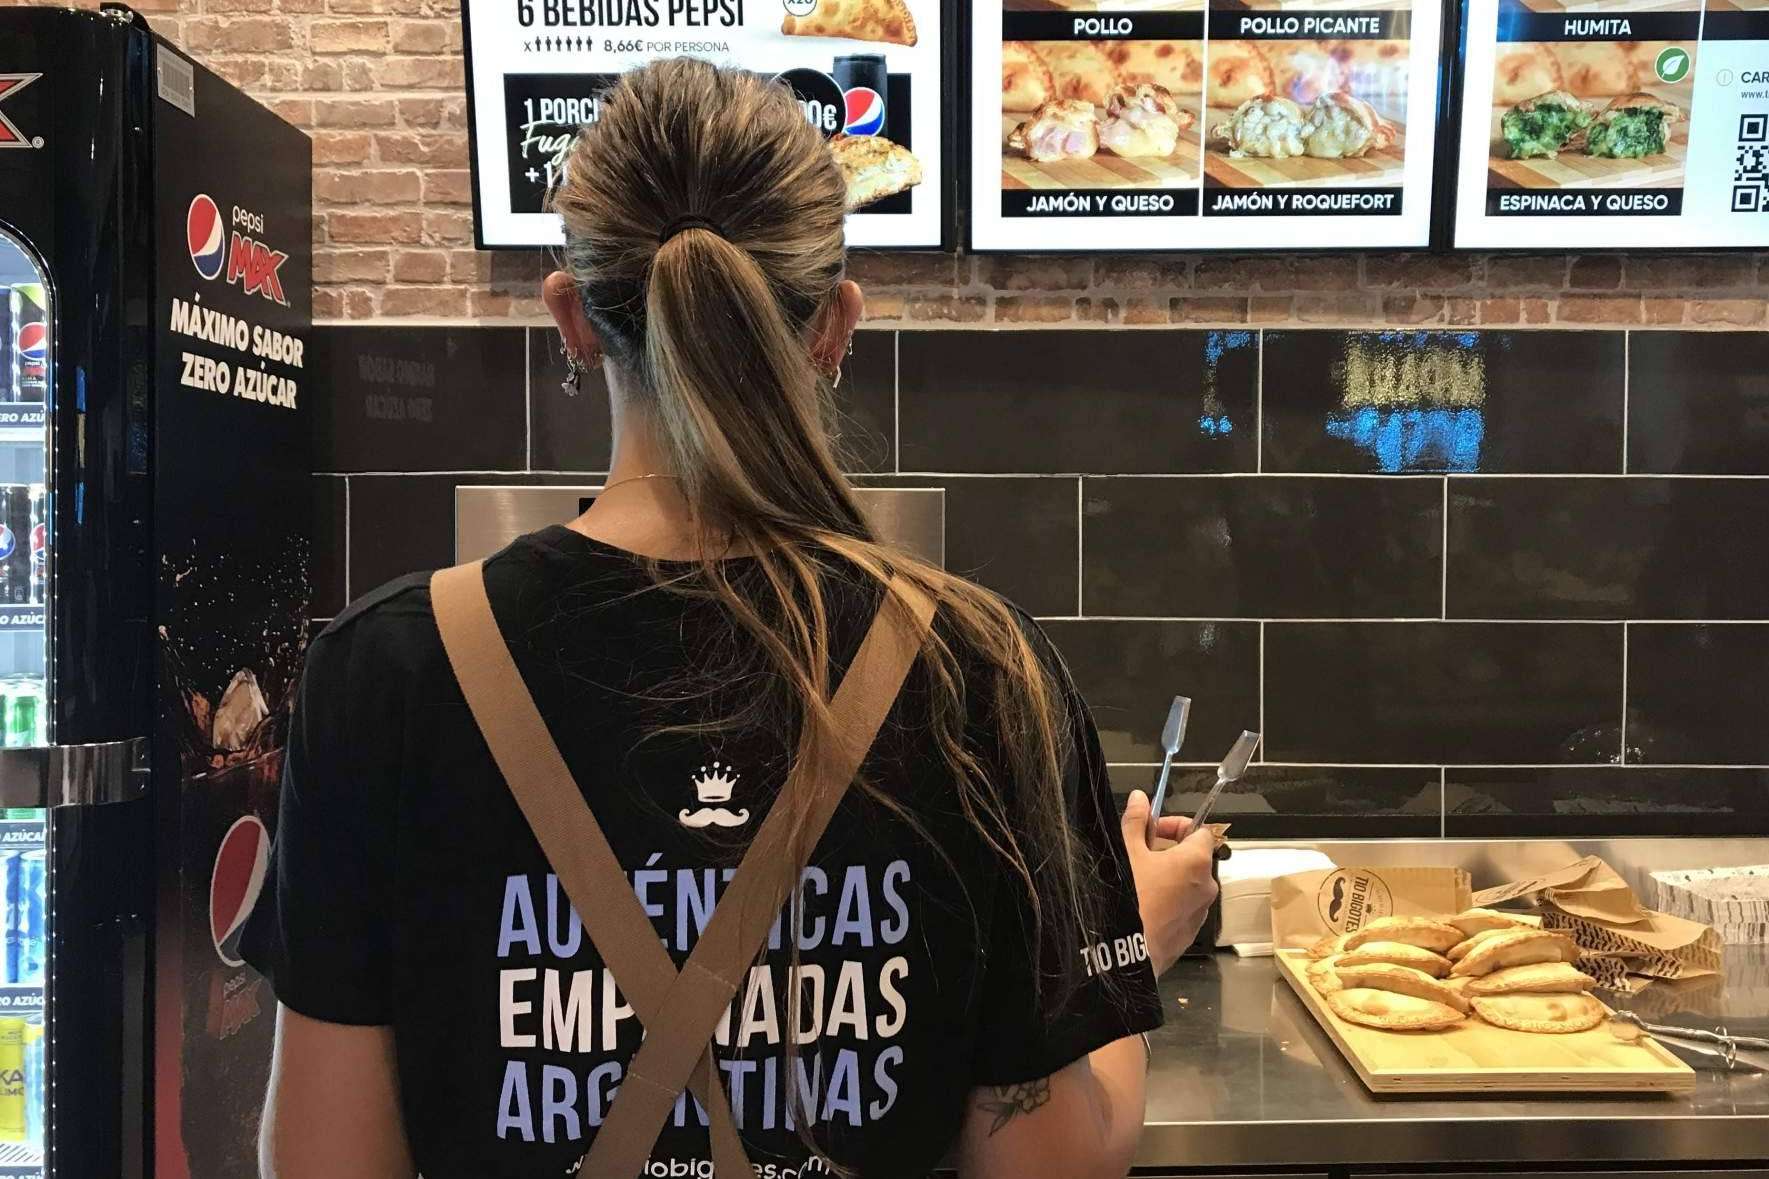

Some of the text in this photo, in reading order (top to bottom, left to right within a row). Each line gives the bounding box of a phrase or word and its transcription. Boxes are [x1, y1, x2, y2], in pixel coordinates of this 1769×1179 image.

[544, 0, 659, 27] BEBIDAS
[669, 0, 744, 27] PEPSI
[1073, 18, 1133, 35] POLLO
[1240, 17, 1380, 35] POLLO PICANTE
[1564, 19, 1632, 36] HUMITA
[604, 40, 643, 54] 8,66€
[647, 41, 671, 51] POR
[675, 41, 730, 52] PERSONA
[1026, 192, 1175, 212] JAMÓN Y QUESO
[1212, 191, 1394, 211] JAMÓN Y ROQUEFORT
[1500, 195, 1669, 212] ESPINACA Y QUESO
[232, 205, 264, 235] pepsi
[226, 230, 289, 305] MAX
[170, 292, 304, 368] MÁXIMO SABOR
[180, 352, 297, 409] ZERO AZÚCAR
[1345, 876, 1370, 934] TIO BIGOTES
[1080, 942, 1113, 977] TIO
[500, 956, 909, 1053] EMPADAS
[497, 1045, 904, 1143] ARGTINAS
